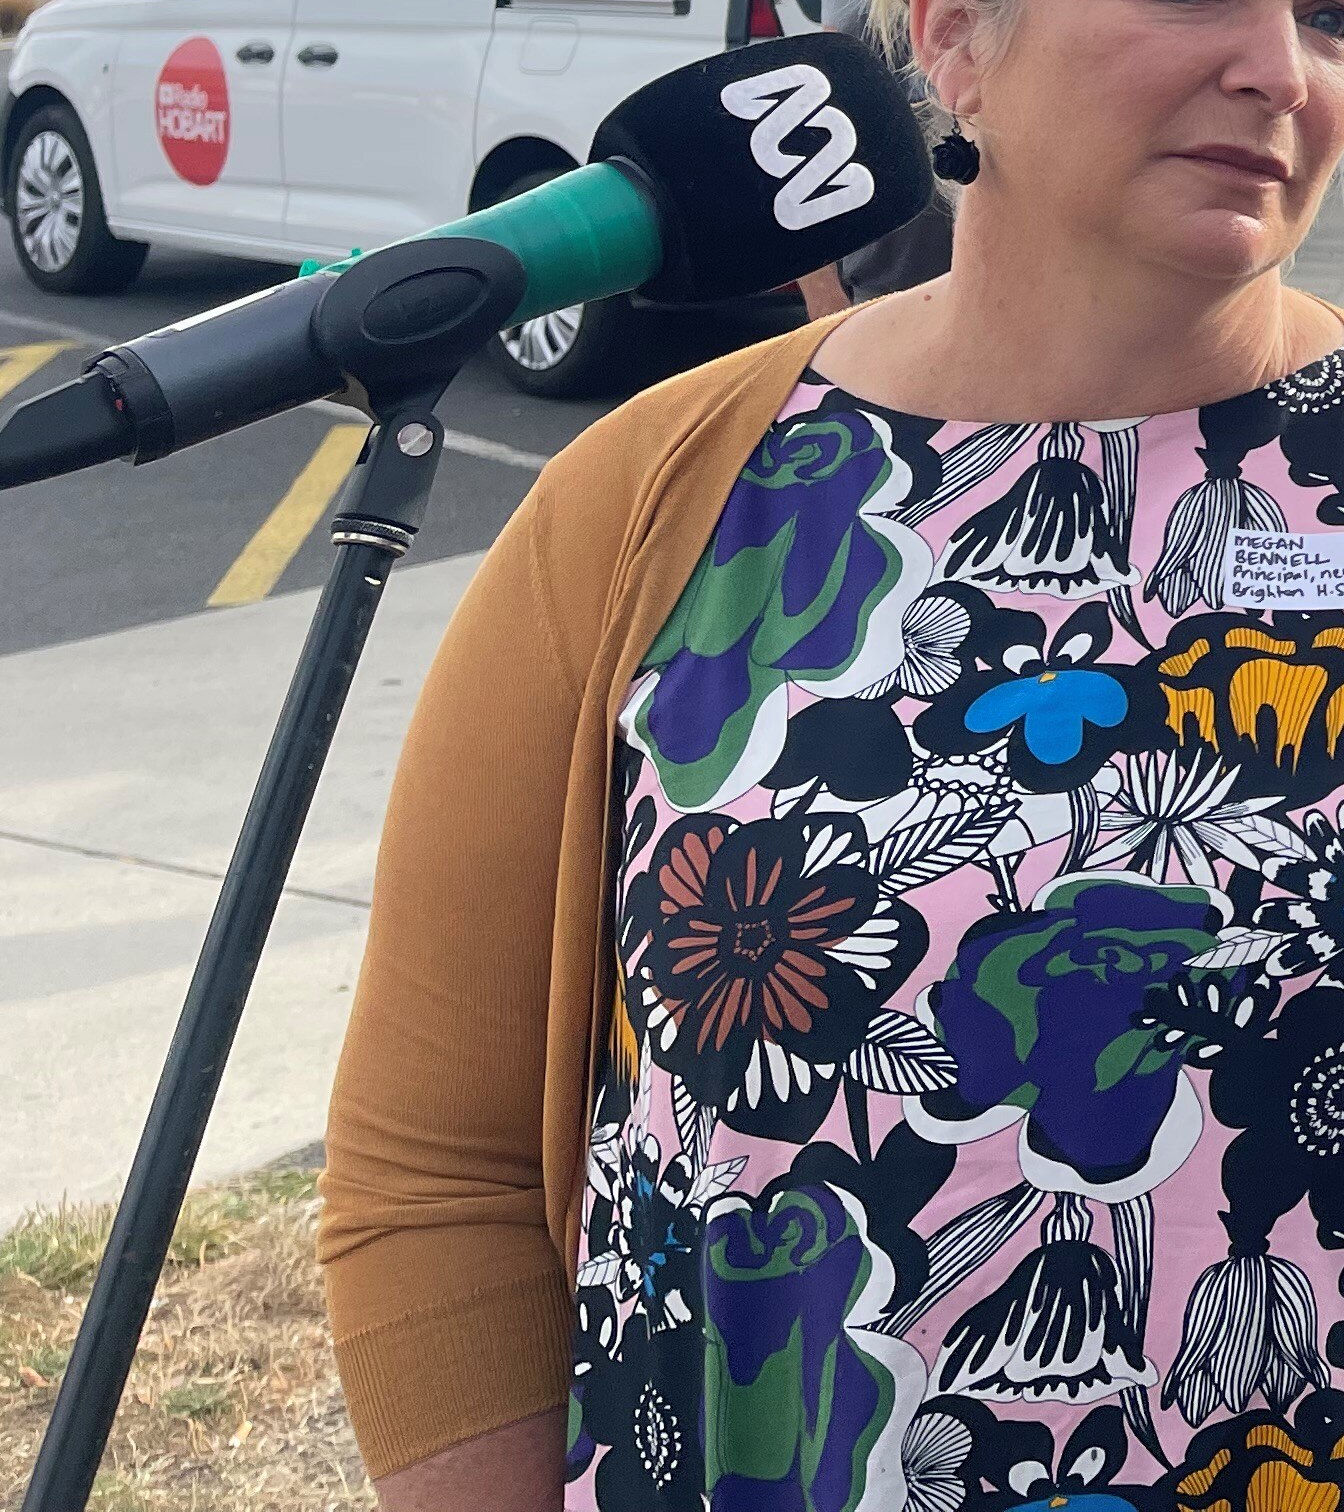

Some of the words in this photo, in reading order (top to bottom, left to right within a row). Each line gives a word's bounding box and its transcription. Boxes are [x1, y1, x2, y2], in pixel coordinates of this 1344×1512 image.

[160, 107, 226, 144] HOBART
[1234, 536, 1304, 551] MEGAN
[1235, 550, 1330, 567] BENNELL
[1232, 582, 1305, 603] Brighton
